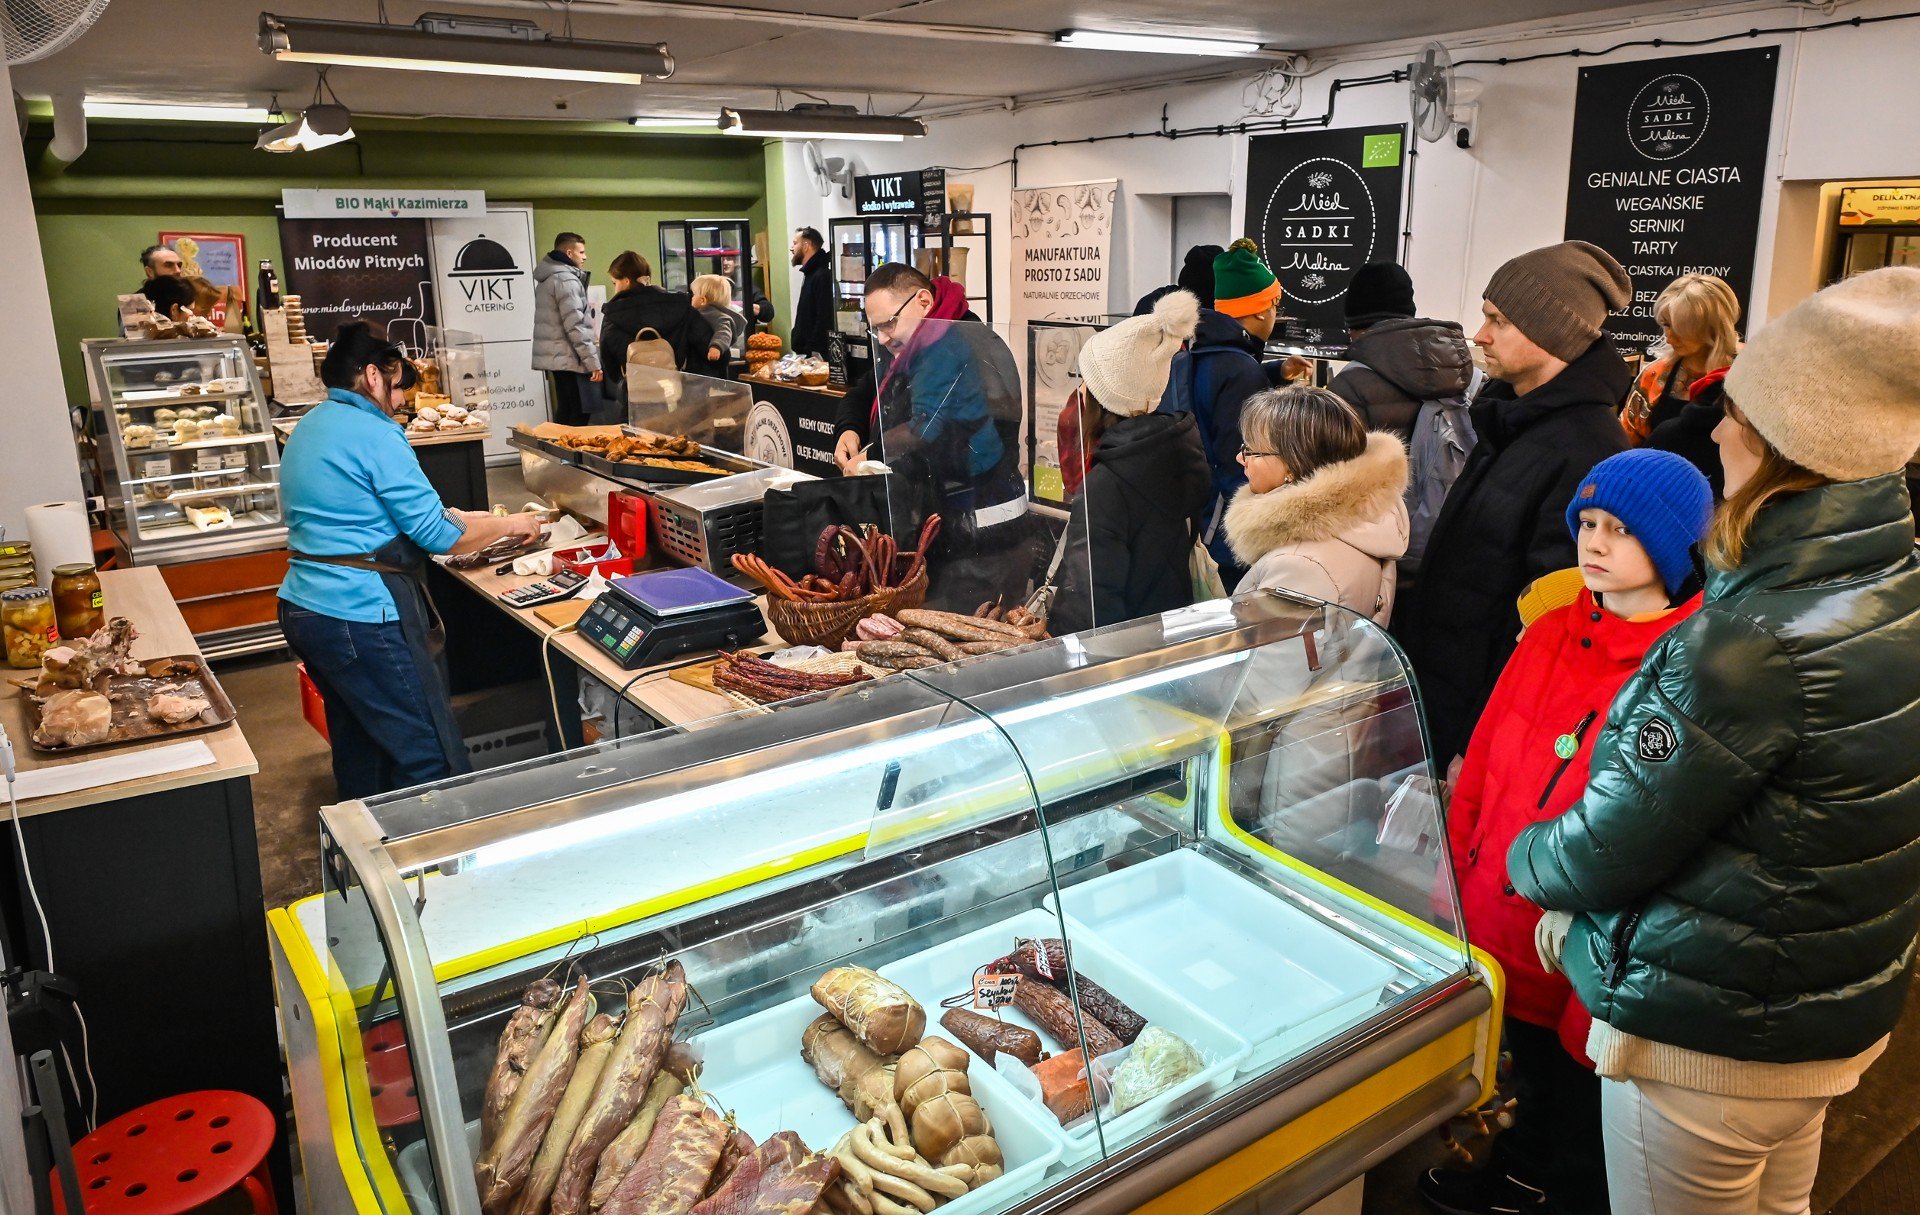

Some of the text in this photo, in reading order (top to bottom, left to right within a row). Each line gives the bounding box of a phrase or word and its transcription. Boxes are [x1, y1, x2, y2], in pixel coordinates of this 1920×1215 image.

[1644, 112, 1691, 123] SADKI
[1641, 129, 1690, 142] Malina
[1587, 166, 1741, 188] GENIALNE CIASTA
[871, 177, 902, 197] VIKT
[335, 197, 469, 211] BIO Mąki Kazimierza
[885, 199, 915, 212] wytrawnie
[1288, 192, 1350, 211] Miód
[1615, 193, 1705, 211] WEGAŃSKIE
[1285, 225, 1350, 238] SADKI
[1629, 219, 1685, 233] SERNIKI
[312, 233, 398, 248] Producent
[1025, 246, 1100, 262] MANUFAKTURA
[1632, 241, 1678, 255] TARTY
[294, 253, 424, 271] Miodów Pitnych
[1281, 252, 1350, 271] Malina
[1025, 268, 1101, 282] PROSTO Z SADU
[1628, 265, 1674, 276] CIASTKA
[1676, 266, 1680, 276] I
[459, 278, 514, 301] VIKT
[1024, 291, 1100, 300] NATURALNIE ORZECHOWE
[1635, 291, 1658, 303] BEZ
[465, 302, 514, 313] CATERING
[799, 417, 817, 430] KREMY
[796, 445, 811, 460] OLEJE
